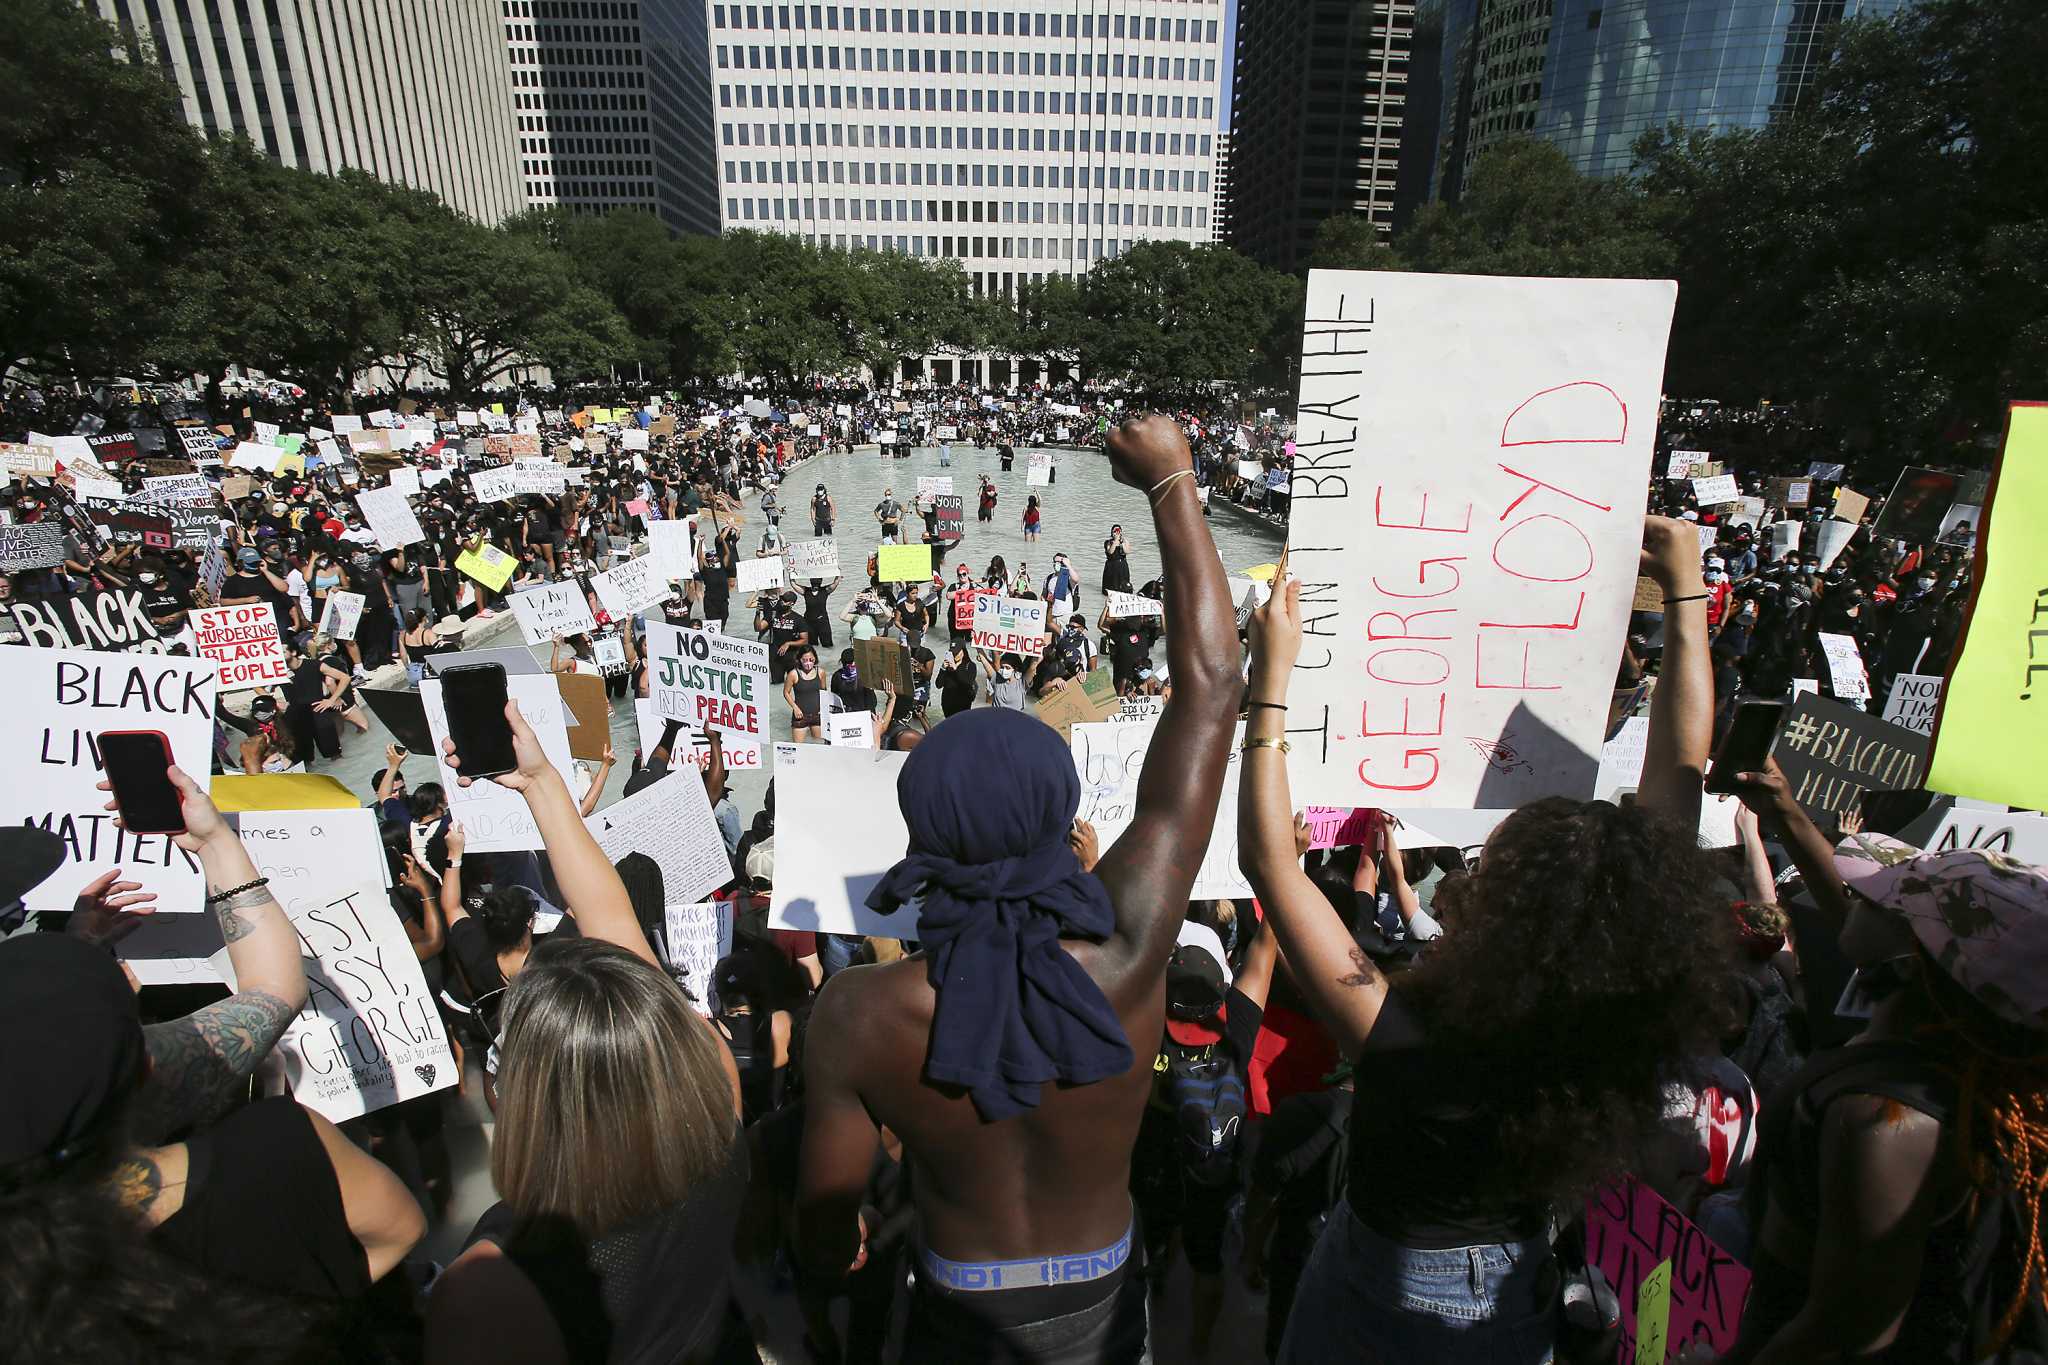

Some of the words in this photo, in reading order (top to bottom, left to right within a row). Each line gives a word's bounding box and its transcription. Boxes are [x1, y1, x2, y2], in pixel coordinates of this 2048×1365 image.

[89, 435, 115, 446] BLACK
[115, 431, 136, 442] LIVES
[181, 428, 211, 439] BLACK
[186, 438, 214, 449] LIVES
[190, 449, 222, 461] MATTER
[1689, 462, 1724, 478] BLM
[89, 498, 110, 510] NO
[936, 495, 962, 509] YOUR
[0, 528, 30, 540] ACK
[938, 520, 946, 530] IS
[950, 520, 964, 532] MY
[1475, 381, 1627, 690] FLOYD
[0, 538, 33, 551] IVES
[12, 589, 158, 649] BLACK
[201, 607, 268, 629] STOP
[978, 596, 1041, 621] Silence
[1115, 603, 1158, 615] MATTER
[195, 623, 279, 645] MURDERING
[971, 630, 1044, 658] VIOLENCE
[1358, 486, 1473, 790] GEORGE
[205, 643, 280, 663] BLACK
[676, 631, 709, 661] NO
[711, 640, 745, 655] #JUSTICE
[748, 644, 764, 657] FOR
[218, 660, 288, 685] EOPLE
[711, 656, 743, 668] GEORGE
[743, 661, 768, 674] FLOYD
[658, 656, 753, 702] JUSTICE
[56, 661, 214, 720] BLACK
[658, 689, 691, 716] NO
[697, 694, 759, 734] PEACE
[40, 728, 103, 772] LIV
[239, 823, 290, 841] mes
[310, 825, 326, 839] a
[257, 851, 311, 878] hen
[297, 891, 372, 958] EST
[300, 945, 412, 1022] ASY,
[299, 995, 439, 1076] GEORGE
